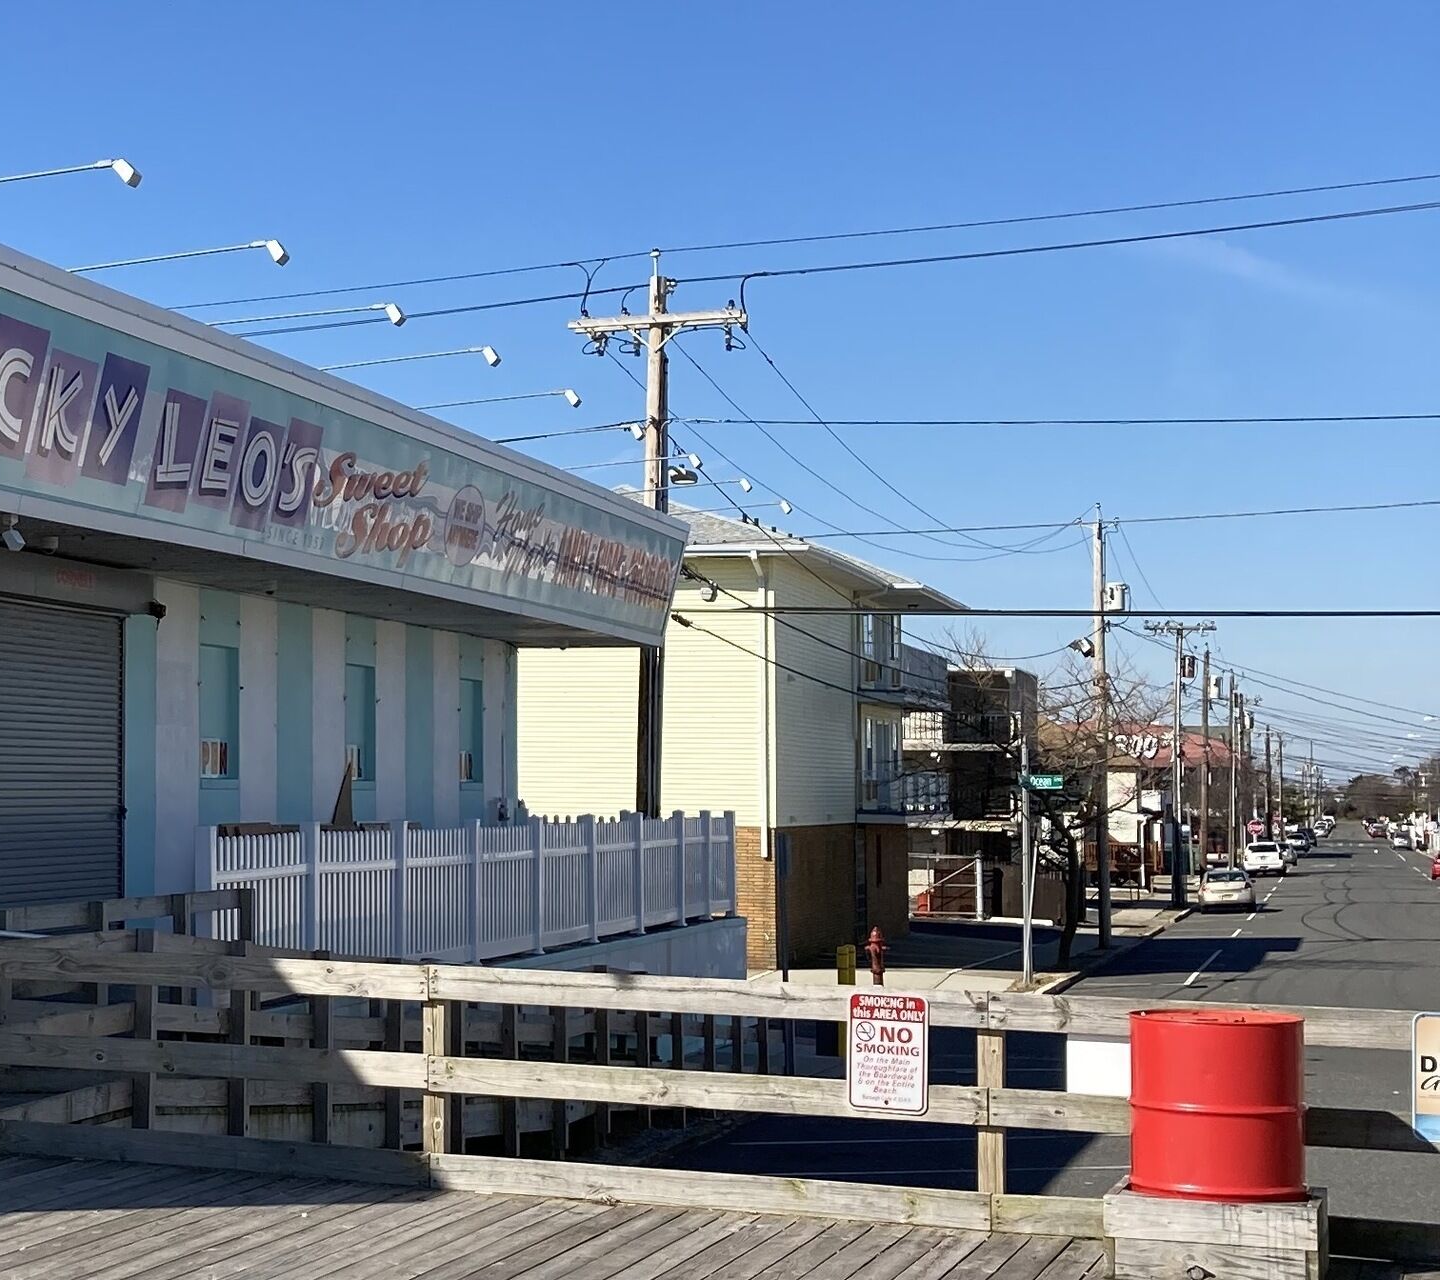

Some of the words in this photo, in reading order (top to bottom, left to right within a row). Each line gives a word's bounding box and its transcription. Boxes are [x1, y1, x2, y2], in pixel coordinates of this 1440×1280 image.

[155, 401, 319, 513] LEO'S
[312, 451, 429, 508] Sweet
[266, 526, 300, 546] SINCE
[335, 502, 433, 568] Shop
[1029, 775, 1053, 787] Ocean
[905, 997, 916, 1009] in
[852, 1006, 871, 1019] this
[872, 1008, 898, 1021] AREA
[900, 1010, 925, 1022] ONLY
[880, 1026, 913, 1044] NO
[856, 1042, 920, 1057] SMOKING
[863, 1055, 874, 1063] On
[876, 1056, 889, 1064] the
[891, 1058, 911, 1066] Main
[856, 1062, 908, 1073] Thoroughfare
[859, 1070, 871, 1078] the
[873, 1071, 914, 1081] Boardwalk
[873, 1086, 897, 1094] Beach
[877, 1079, 890, 1087] the
[891, 1080, 915, 1089] Entire
